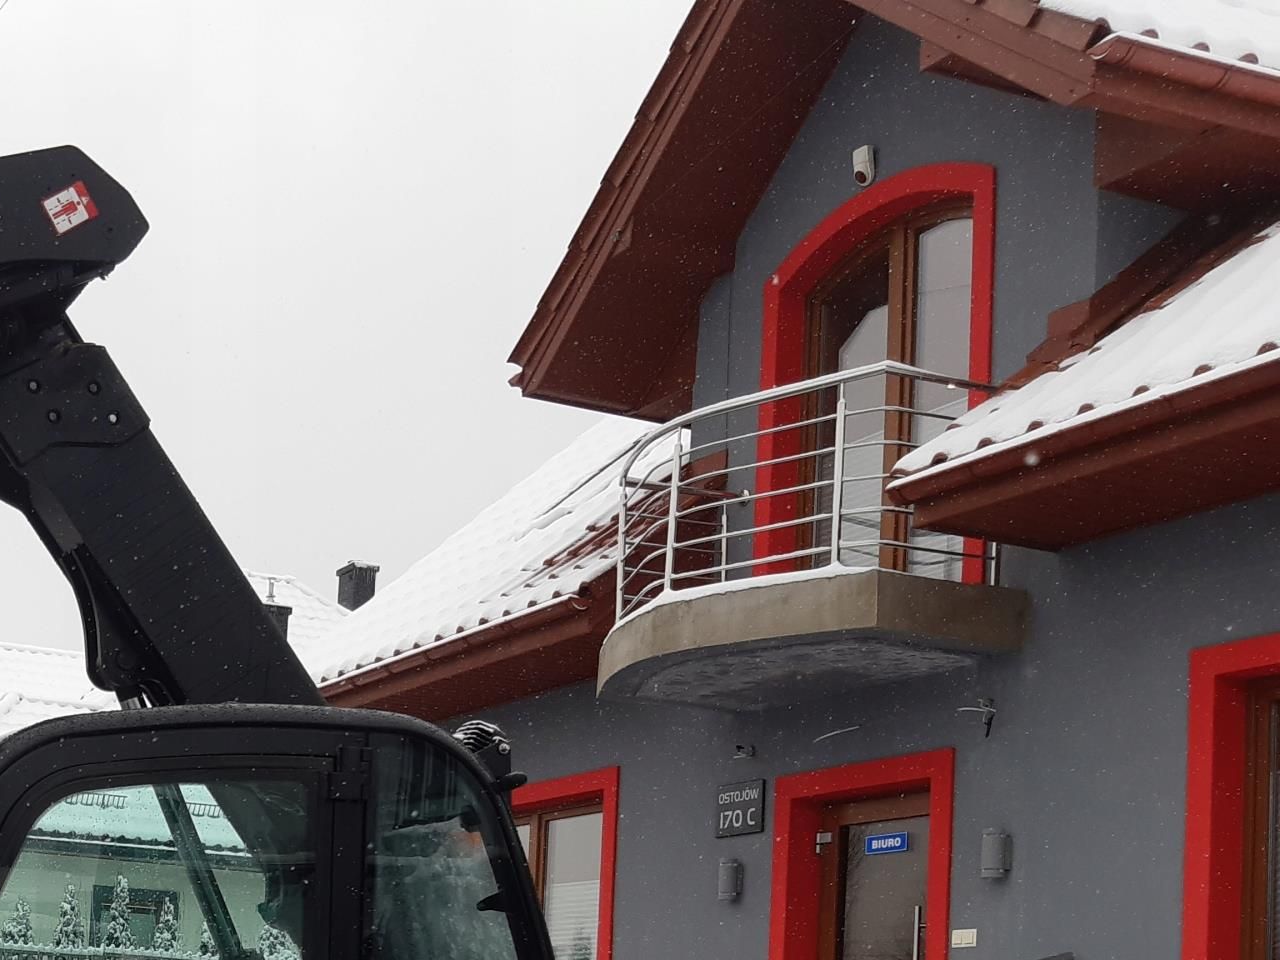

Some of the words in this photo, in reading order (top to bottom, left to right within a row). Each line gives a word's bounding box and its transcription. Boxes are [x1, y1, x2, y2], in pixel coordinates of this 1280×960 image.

[718, 787, 759, 805] OSTOJÓW
[719, 809, 743, 829] 170
[746, 808, 756, 825] C
[871, 837, 901, 850] BIURO
